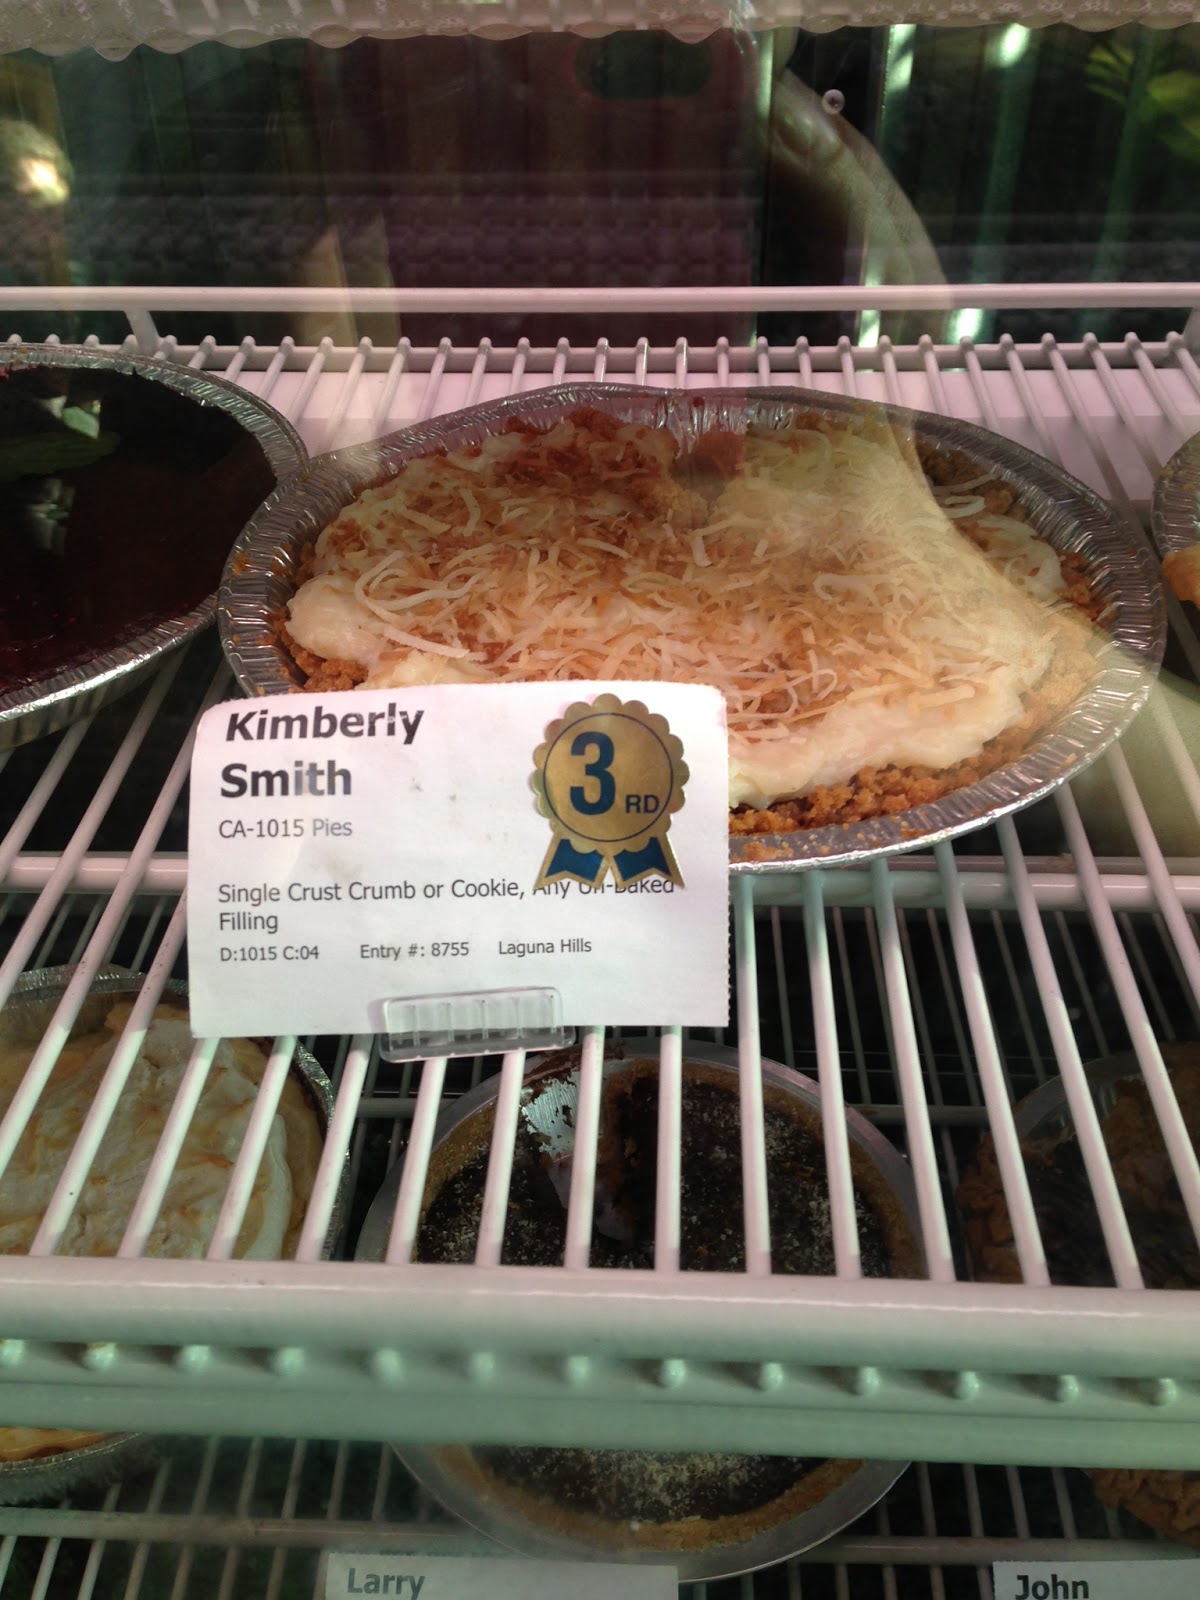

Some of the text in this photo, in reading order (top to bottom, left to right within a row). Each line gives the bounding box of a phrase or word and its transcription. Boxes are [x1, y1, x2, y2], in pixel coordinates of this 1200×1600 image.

[225, 702, 424, 745] Kimberly
[220, 760, 352, 798] Smith
[569, 731, 660, 816] 3 RD
[218, 818, 353, 838] CA-1015 Pies
[218, 883, 281, 906] Single
[288, 882, 342, 901] Crust
[349, 881, 416, 900] Crumb
[423, 883, 445, 898] or
[451, 878, 525, 899] Cookie,
[219, 911, 279, 934] Filling
[219, 945, 320, 962] D:1015 C:04
[360, 941, 470, 961] Entry #: 8755
[498, 938, 592, 957] Laguna Hills
[347, 1568, 426, 1600] Larry
[1015, 1574, 1090, 1600] John
